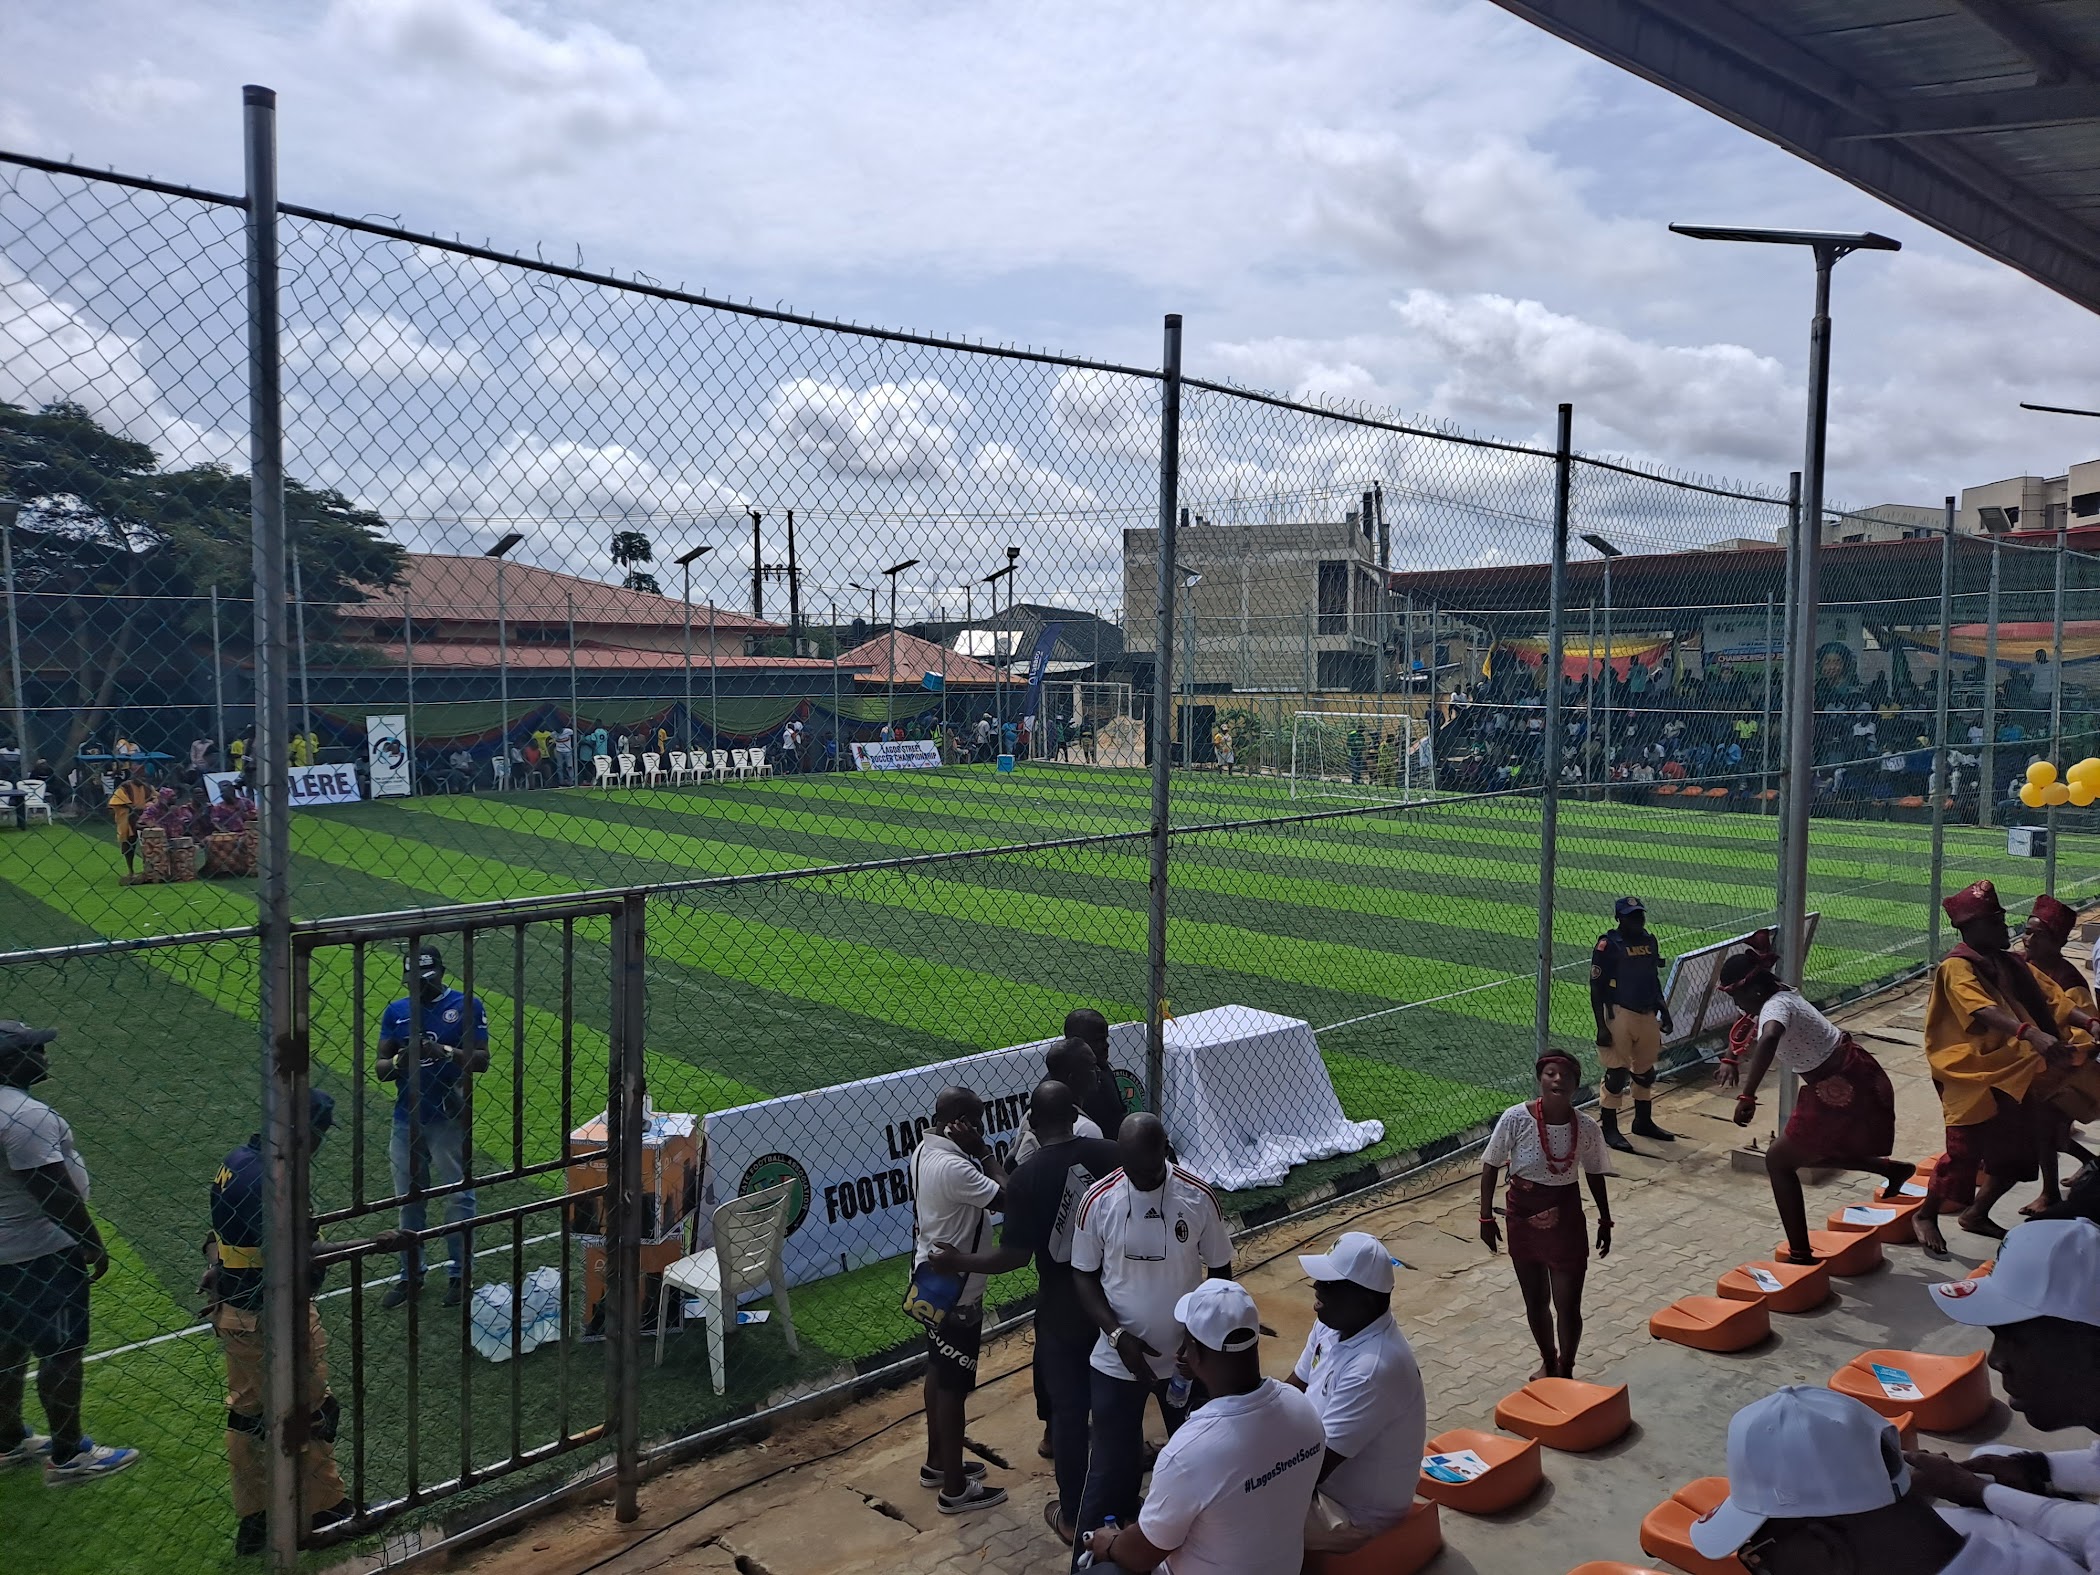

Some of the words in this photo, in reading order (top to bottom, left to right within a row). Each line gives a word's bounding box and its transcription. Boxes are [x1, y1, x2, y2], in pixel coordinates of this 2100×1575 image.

[749, 1155, 785, 1174] FOOTBALL
[787, 1159, 810, 1210] ASSOCIATION
[824, 1165, 915, 1224] FOOTB
[1055, 1187, 1073, 1236] PALACE
